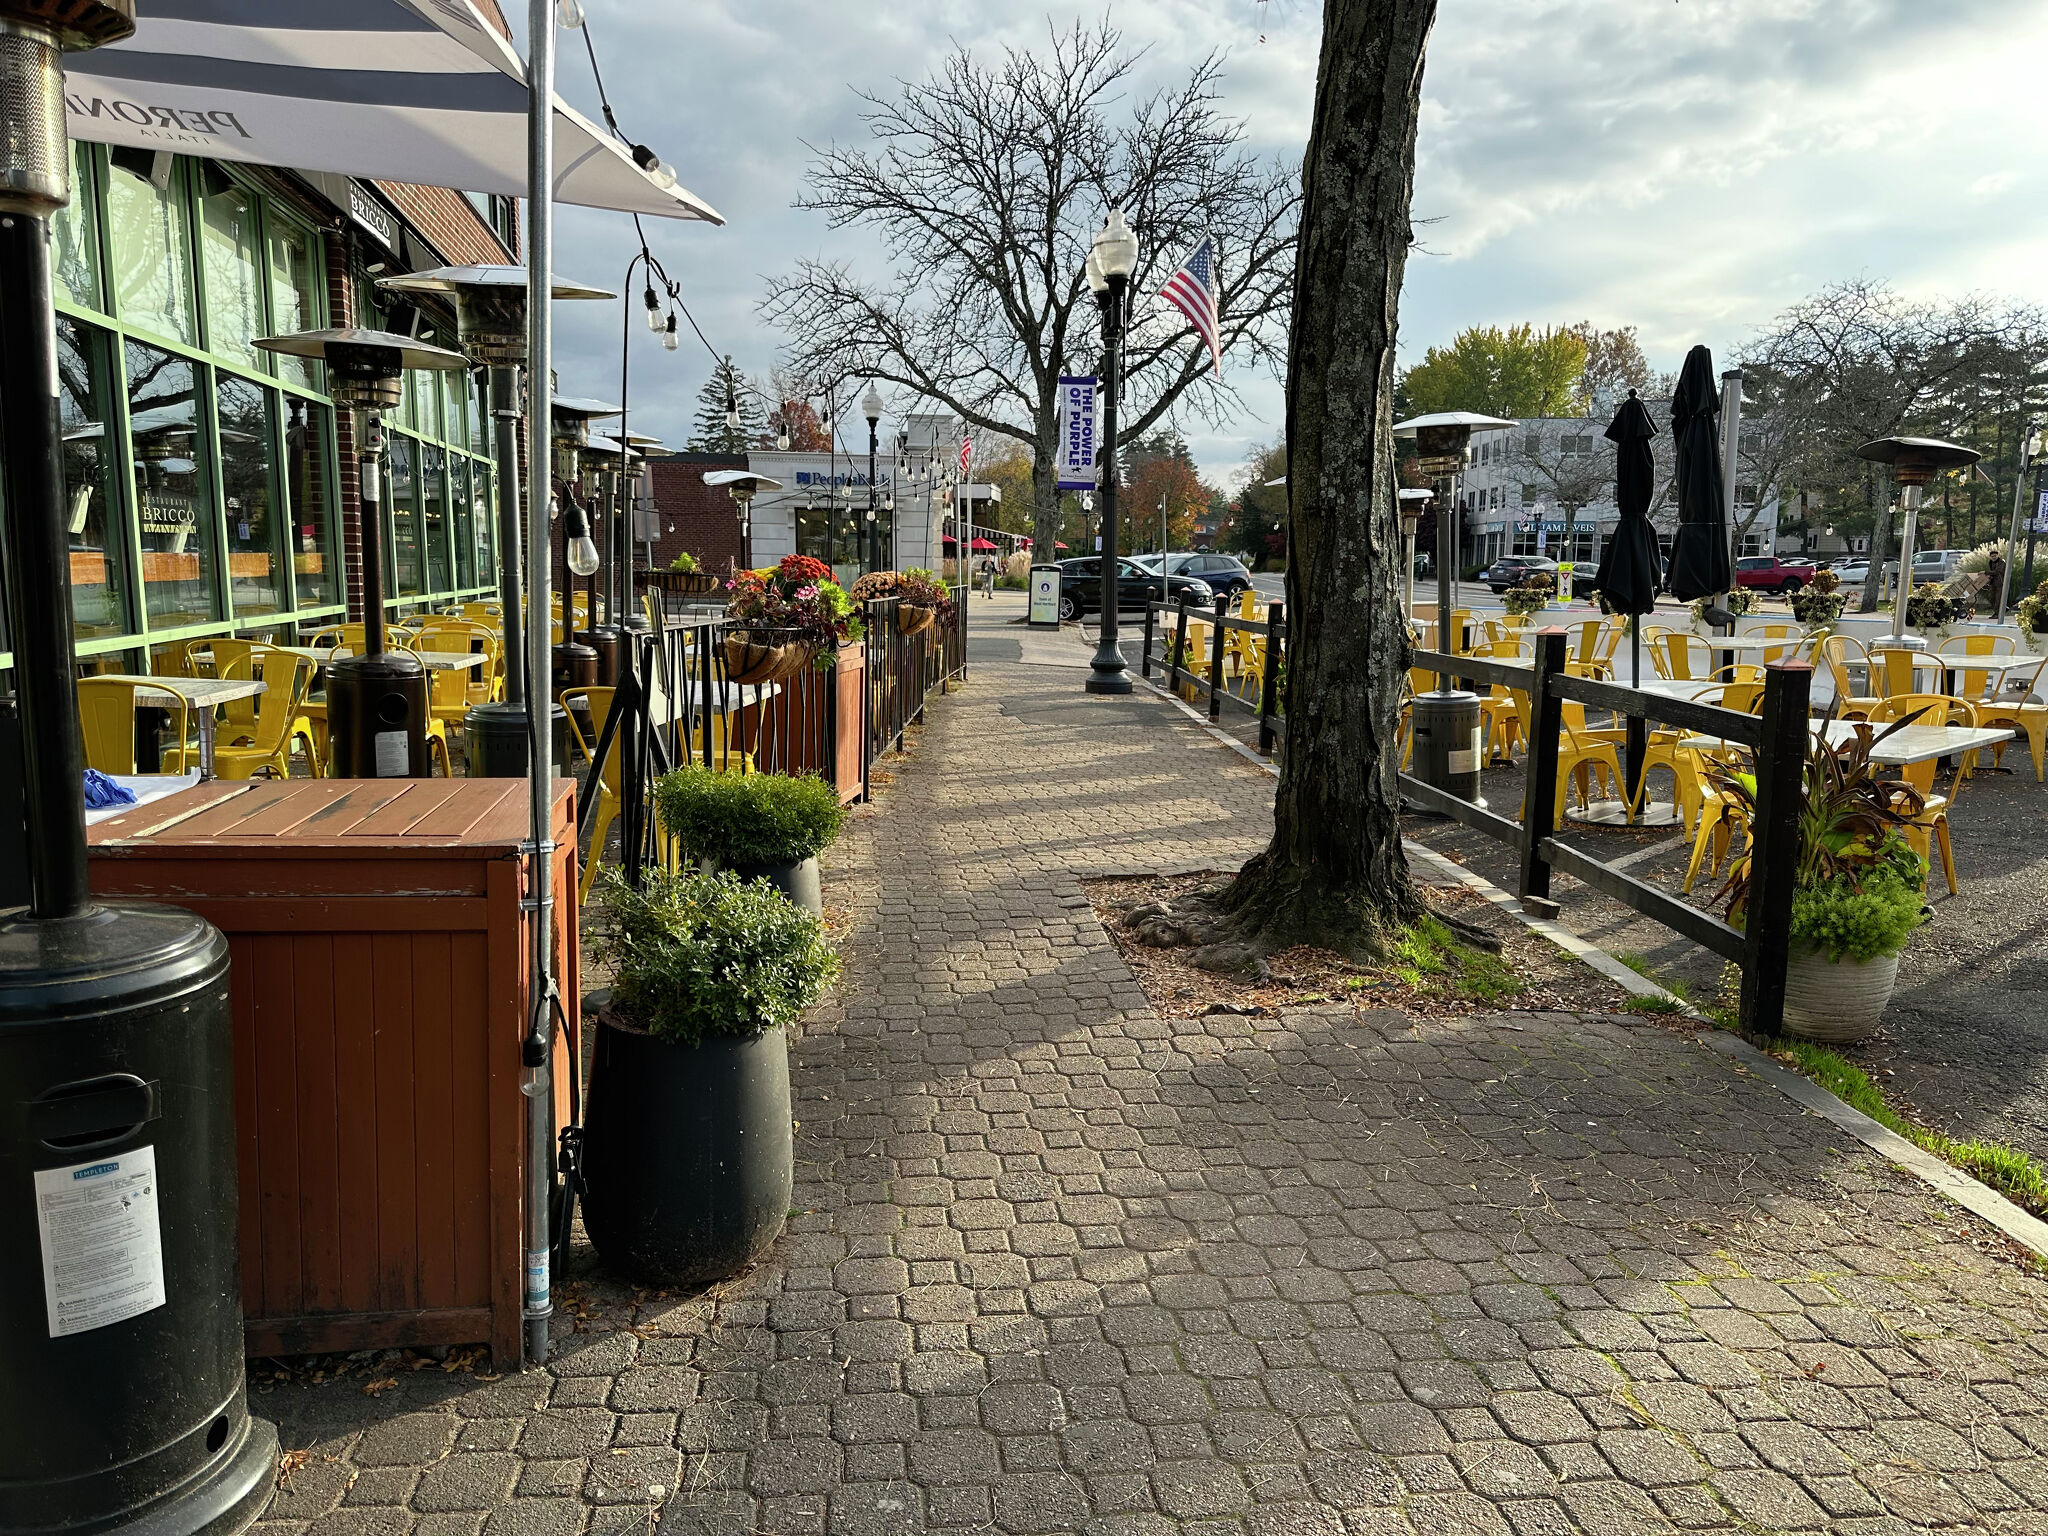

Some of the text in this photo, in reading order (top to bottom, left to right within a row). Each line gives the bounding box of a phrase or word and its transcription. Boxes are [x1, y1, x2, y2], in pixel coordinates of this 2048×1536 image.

[350, 193, 390, 238] BRICCO
[1068, 387, 1081, 466] OF PURPLE
[1081, 387, 1093, 466] THE POWER
[142, 506, 195, 522] BRICCO
[75, 1164, 118, 1178] TEMPLETON
